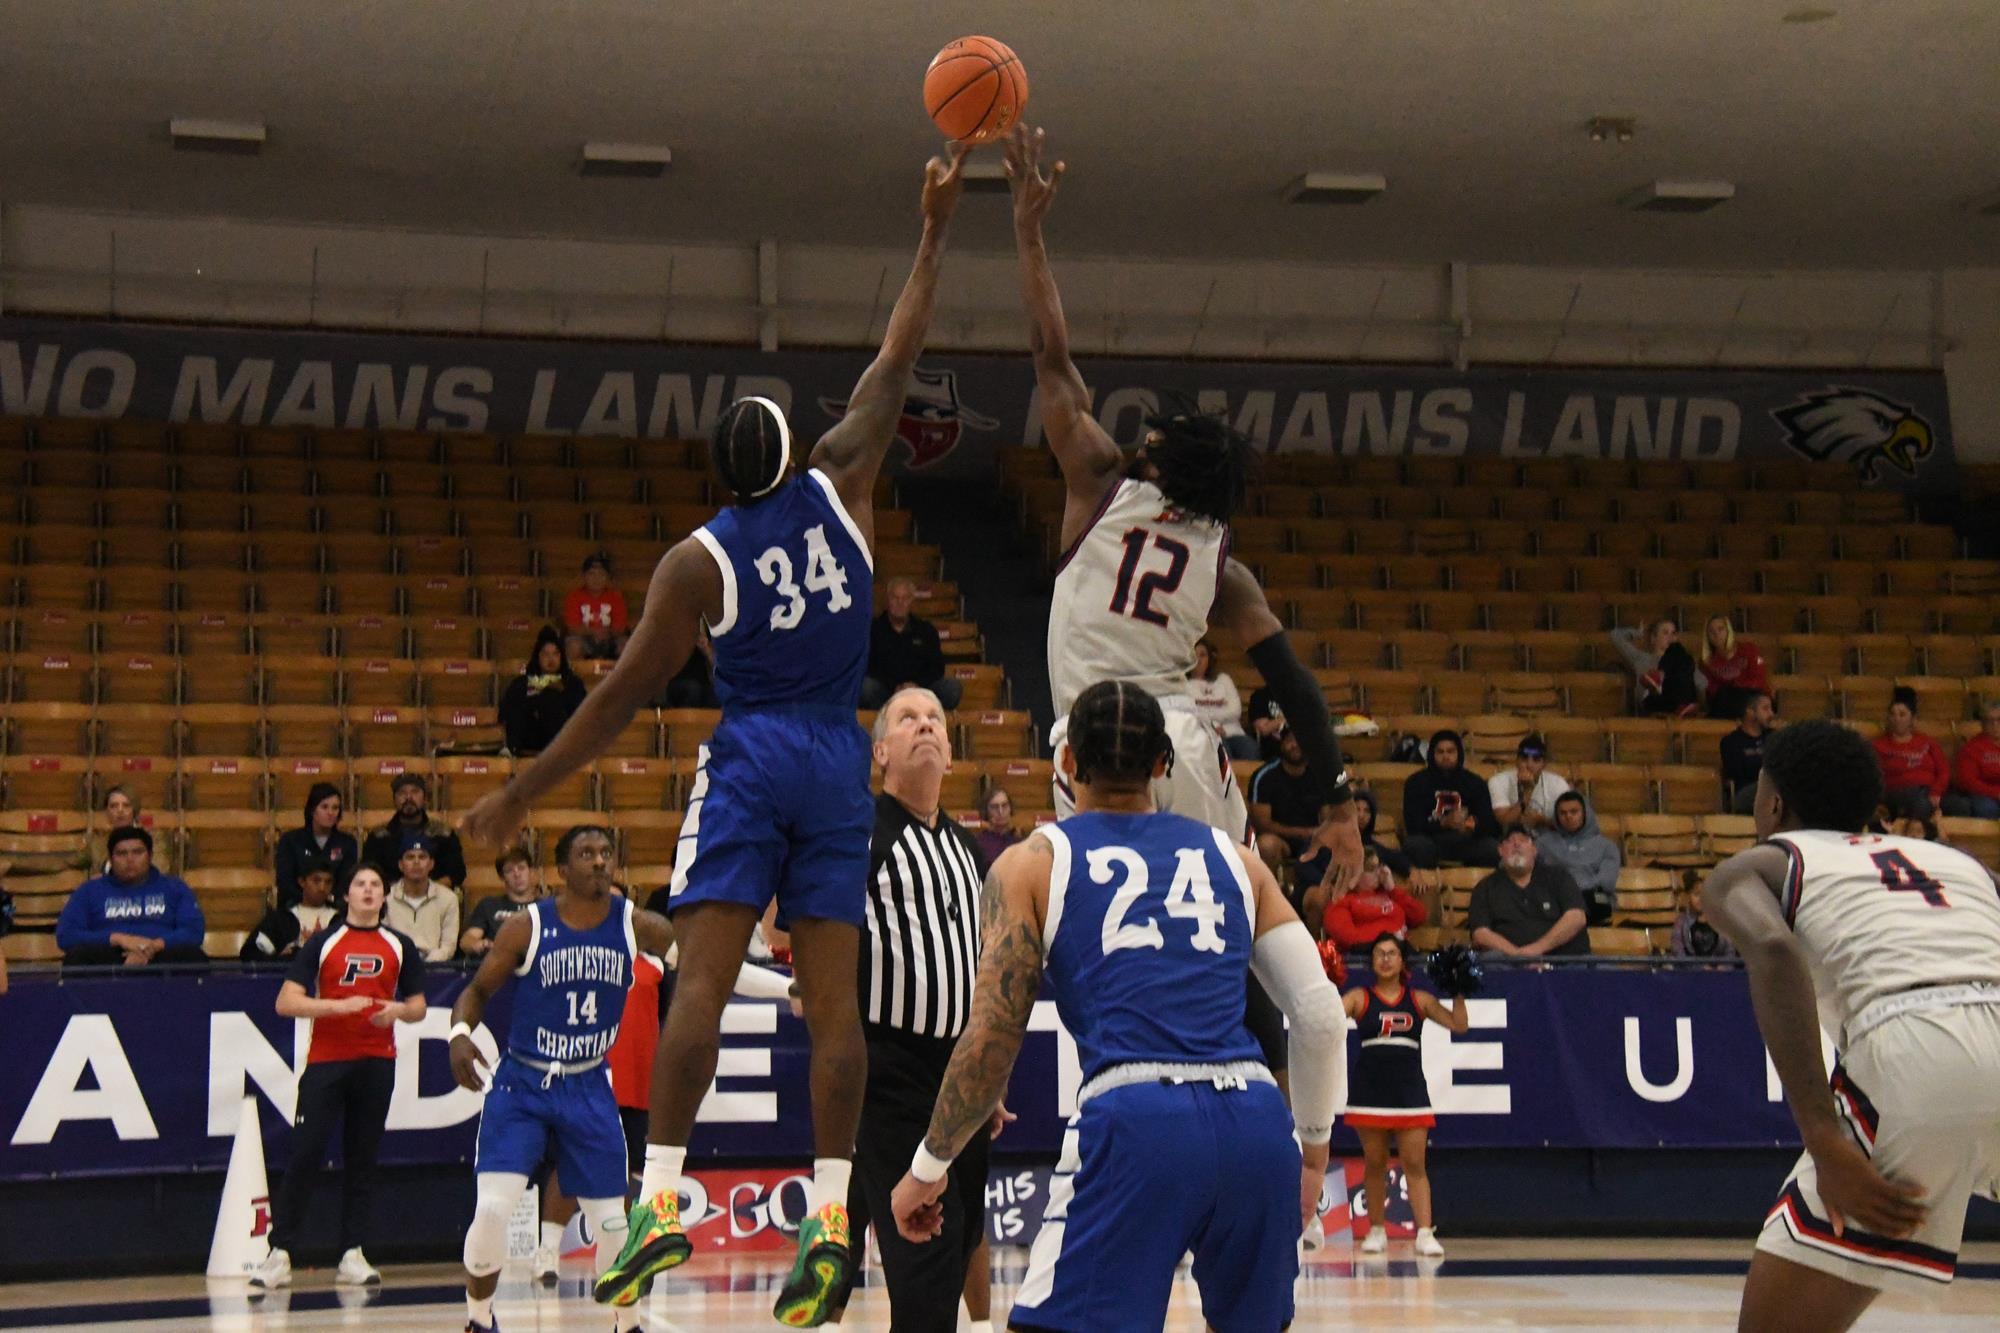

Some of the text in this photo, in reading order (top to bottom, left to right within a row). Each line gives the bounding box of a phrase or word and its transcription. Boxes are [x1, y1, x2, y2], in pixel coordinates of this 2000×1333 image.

[0, 339, 136, 418] NO
[168, 355, 494, 433] MANS
[1502, 390, 1743, 462] LAND
[753, 523, 852, 631] 34
[1109, 526, 1190, 630] 12
[1086, 845, 1225, 956] 24
[1869, 849, 1952, 909] 4
[339, 953, 384, 986] P
[540, 945, 625, 989] SOUTHWESTERN
[566, 990, 598, 1026] 14
[1377, 1011, 1414, 1039] P
[537, 1022, 621, 1061] CHRISTIAN
[993, 1207, 1025, 1241] IS
